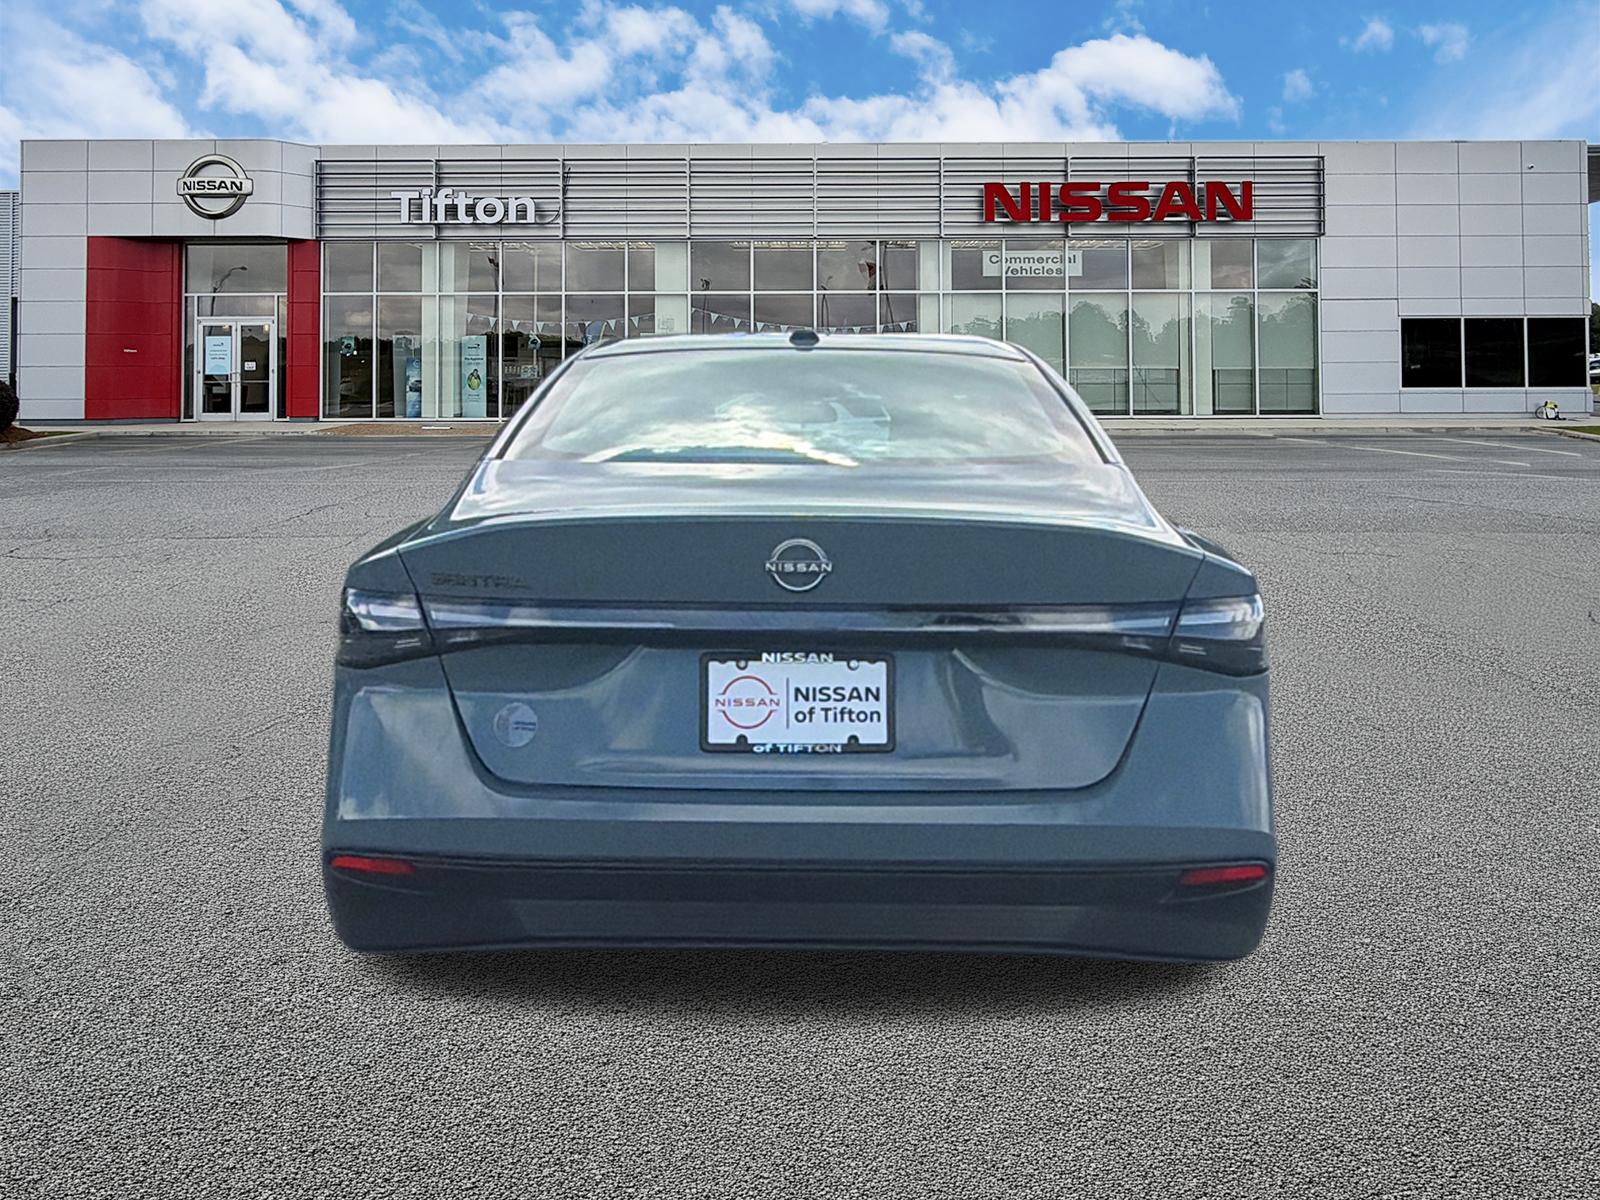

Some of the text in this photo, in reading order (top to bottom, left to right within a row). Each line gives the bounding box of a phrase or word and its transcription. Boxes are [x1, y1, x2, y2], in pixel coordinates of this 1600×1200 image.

[182, 180, 243, 191] NISSAN
[391, 187, 536, 224] Tifton
[984, 181, 1254, 222] NISSAN
[765, 562, 832, 573] NISSAN
[761, 652, 834, 664] NISSAN
[794, 686, 881, 702] NISSAN
[715, 698, 780, 707] NISSAN
[794, 707, 881, 723] of Tifton
[753, 743, 842, 753] of TIFTON
